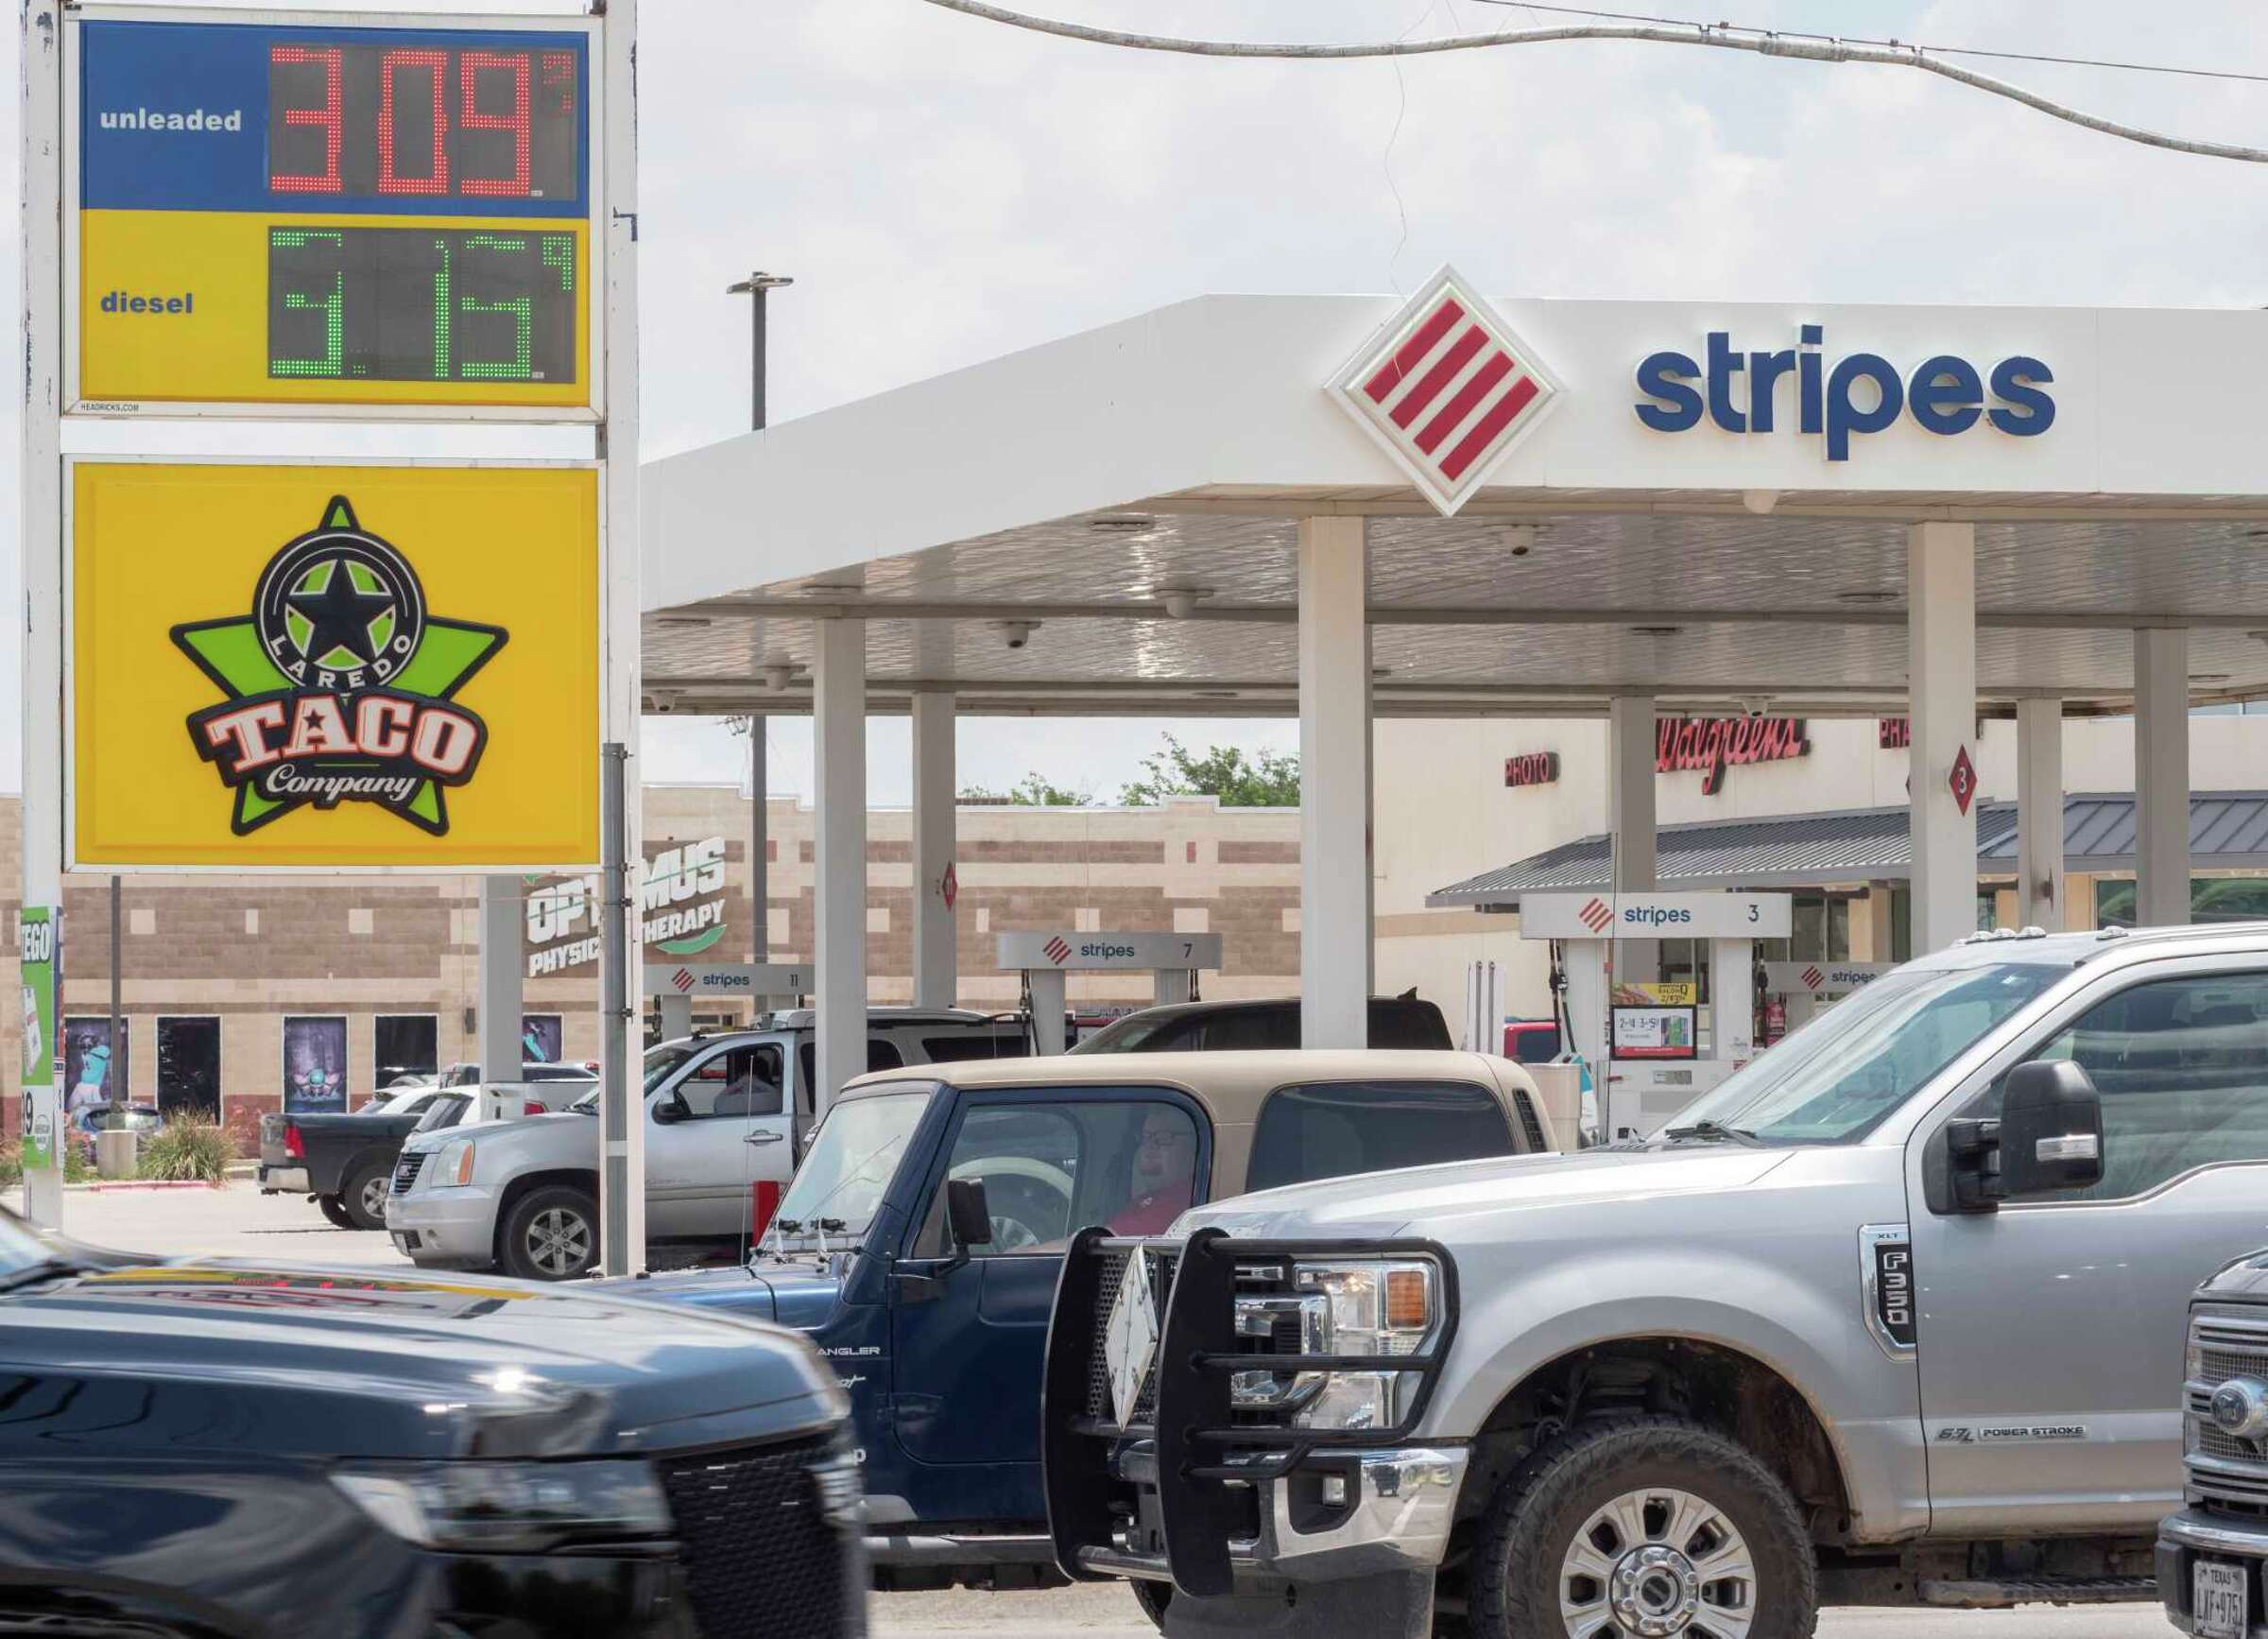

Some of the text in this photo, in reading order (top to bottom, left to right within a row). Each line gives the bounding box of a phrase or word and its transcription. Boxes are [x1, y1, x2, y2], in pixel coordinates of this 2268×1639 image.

[99, 106, 242, 131] unleaded
[100, 290, 193, 314] diesel
[1634, 323, 2056, 461] stripes
[269, 633, 411, 690] LAREDO
[203, 693, 479, 776] TACO
[1504, 751, 1550, 785] PHOTO
[1958, 767, 1967, 795] 3
[266, 763, 418, 802] Company
[526, 837, 727, 944] OPTMUS
[1624, 904, 1760, 927] stripes 3
[21, 922, 51, 961] EGO
[1080, 942, 1194, 959] stripes 7
[529, 937, 599, 977] PHYSIC
[702, 973, 799, 988] stripes 11
[816, 1346, 881, 1356] ANGLER
[1984, 1427, 2029, 1437] POWER
[2032, 1426, 2085, 1437] STROKE
[2210, 1569, 2232, 1586] TEXAS
